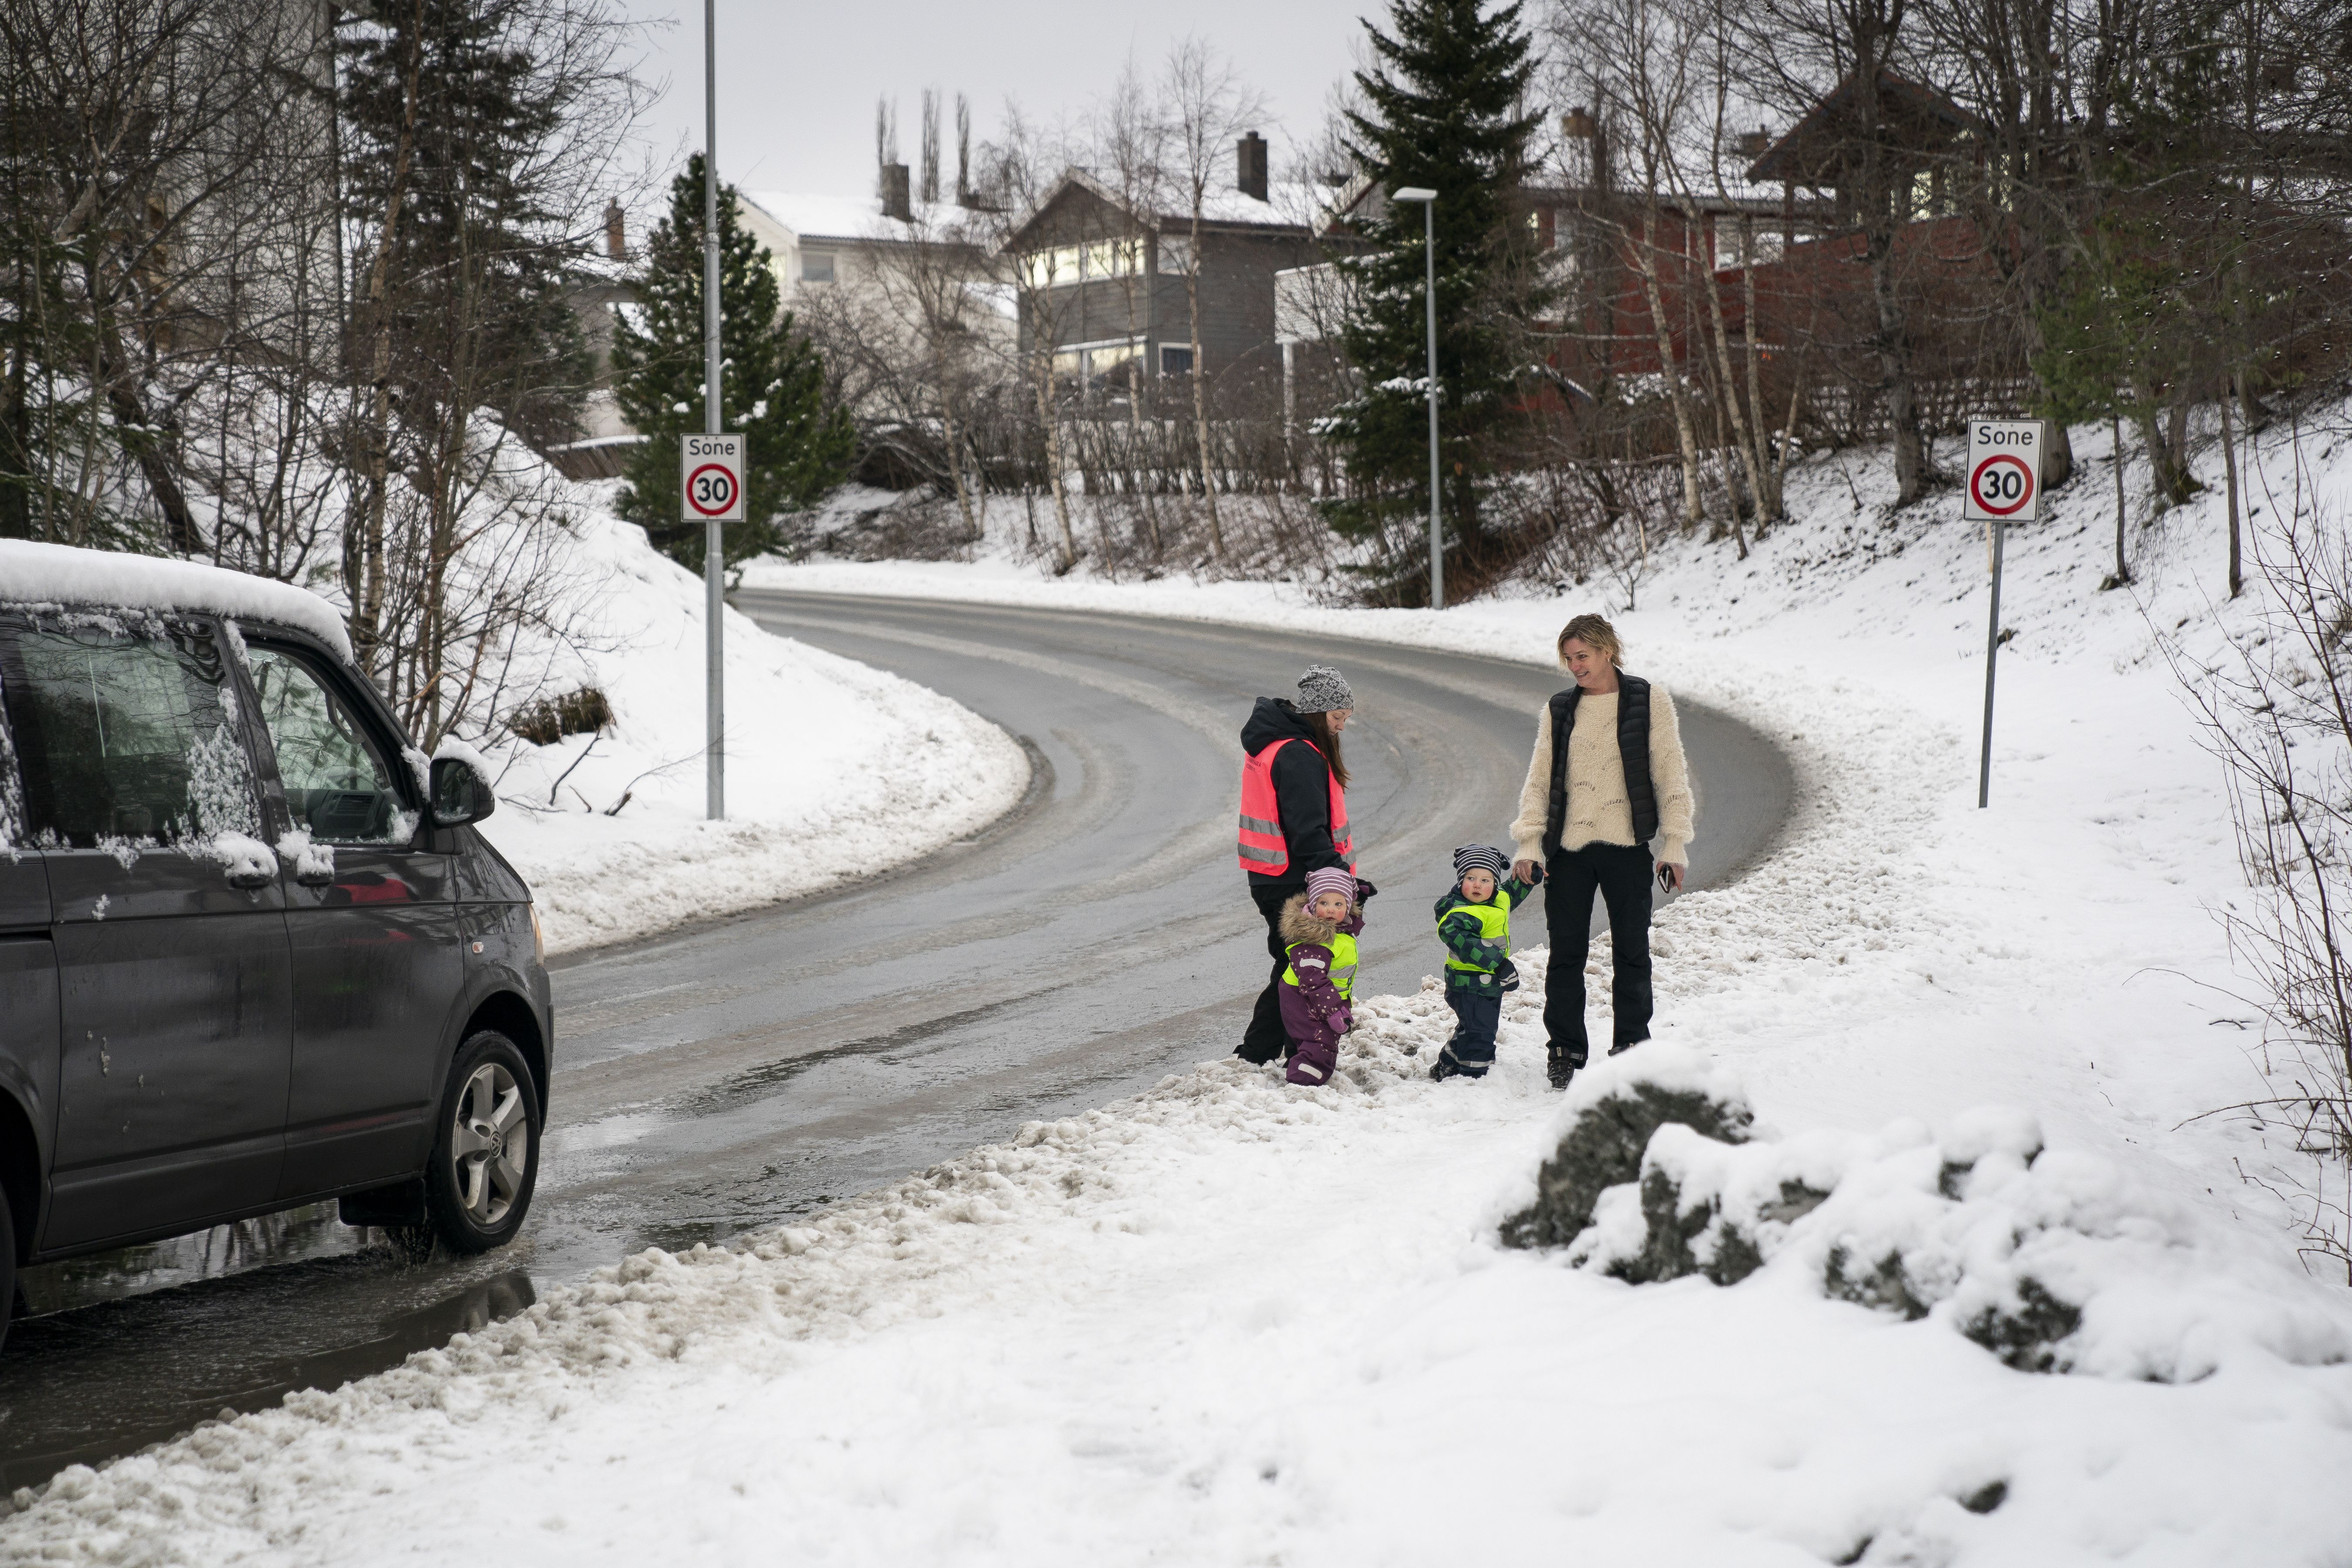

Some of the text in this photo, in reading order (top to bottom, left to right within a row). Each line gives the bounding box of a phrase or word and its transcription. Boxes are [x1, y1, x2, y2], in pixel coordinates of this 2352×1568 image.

[1978, 425, 2033, 446] Sone
[689, 439, 735, 456] Sone
[696, 477, 729, 502] 30
[1983, 470, 2022, 500] 30
